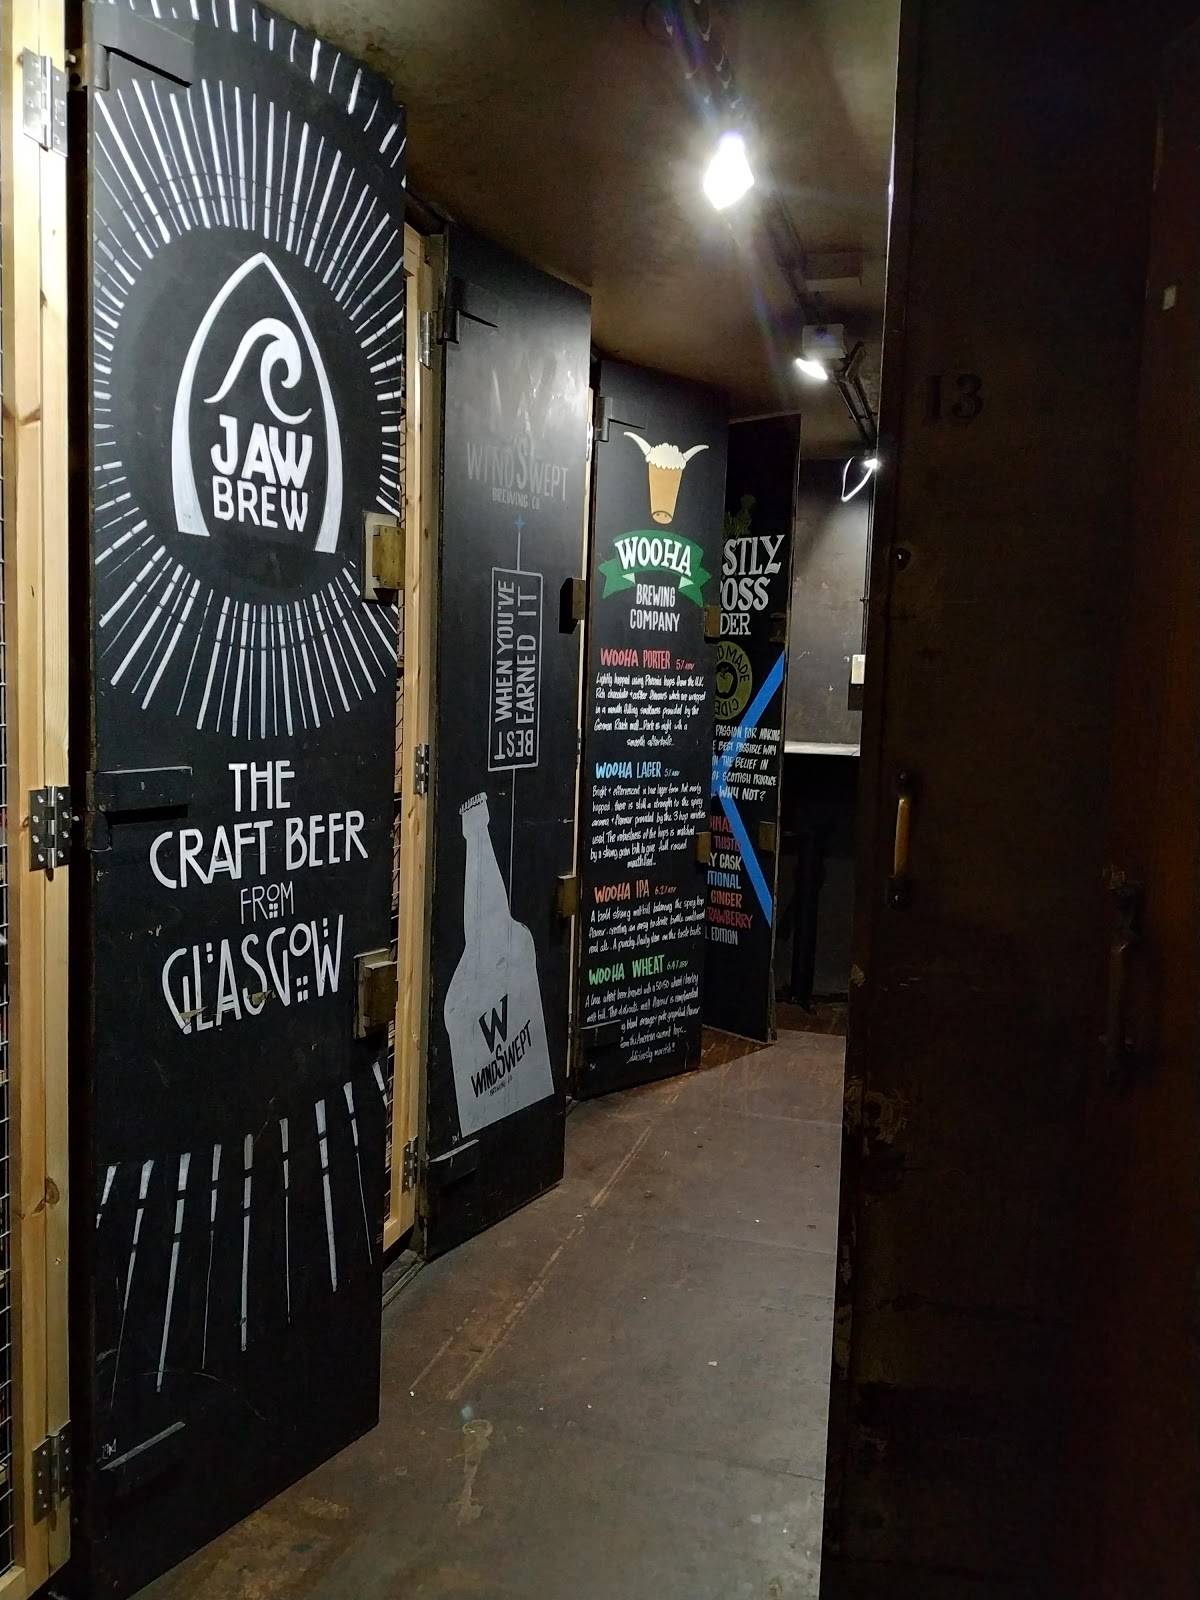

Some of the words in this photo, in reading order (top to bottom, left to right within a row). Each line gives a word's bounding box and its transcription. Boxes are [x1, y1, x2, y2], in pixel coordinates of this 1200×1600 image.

[927, 373, 984, 418] 13
[210, 414, 313, 489] JAW
[211, 475, 309, 533] BREW
[492, 487, 528, 508] BREWING
[614, 536, 692, 577] WOOHA
[517, 585, 537, 616] IT
[636, 583, 676, 608] BREWING
[720, 576, 771, 611] OSS
[496, 580, 515, 655] YOU'VE
[630, 608, 680, 633] COMPANY
[601, 648, 638, 667] WOOHA
[643, 650, 670, 669] PORTER
[716, 645, 750, 682] DMADE
[495, 660, 513, 723] WHEN
[515, 634, 537, 724] EARNED
[494, 729, 534, 760] BEST
[715, 724, 743, 738] PASSION
[744, 727, 757, 738] FOR
[718, 740, 734, 751] BEST
[736, 741, 762, 755] POSSIBLE
[596, 762, 632, 779] WOOHA
[637, 762, 661, 778] LAGER
[722, 771, 751, 784] SCOTTISH
[735, 756, 759, 770] BELIEF
[759, 758, 769, 771] IN
[228, 760, 295, 812] THE
[719, 786, 739, 800] WHY
[742, 787, 767, 801] NOT?
[673, 811, 678, 821] 3
[149, 820, 273, 889] CRAFT
[285, 810, 369, 871] BEER
[719, 853, 742, 872] CASK
[240, 881, 294, 924] FROM
[594, 883, 630, 903] WOOHA
[636, 880, 649, 898] IPA
[710, 889, 743, 909] GINGER
[591, 910, 595, 922] A
[711, 926, 739, 946] EDITION
[162, 914, 343, 1035] GLASGOW
[589, 963, 624, 985] WOOHA
[632, 954, 664, 978] WHEAT
[478, 993, 508, 1053] W
[471, 1019, 533, 1098] WINDSWEPT
